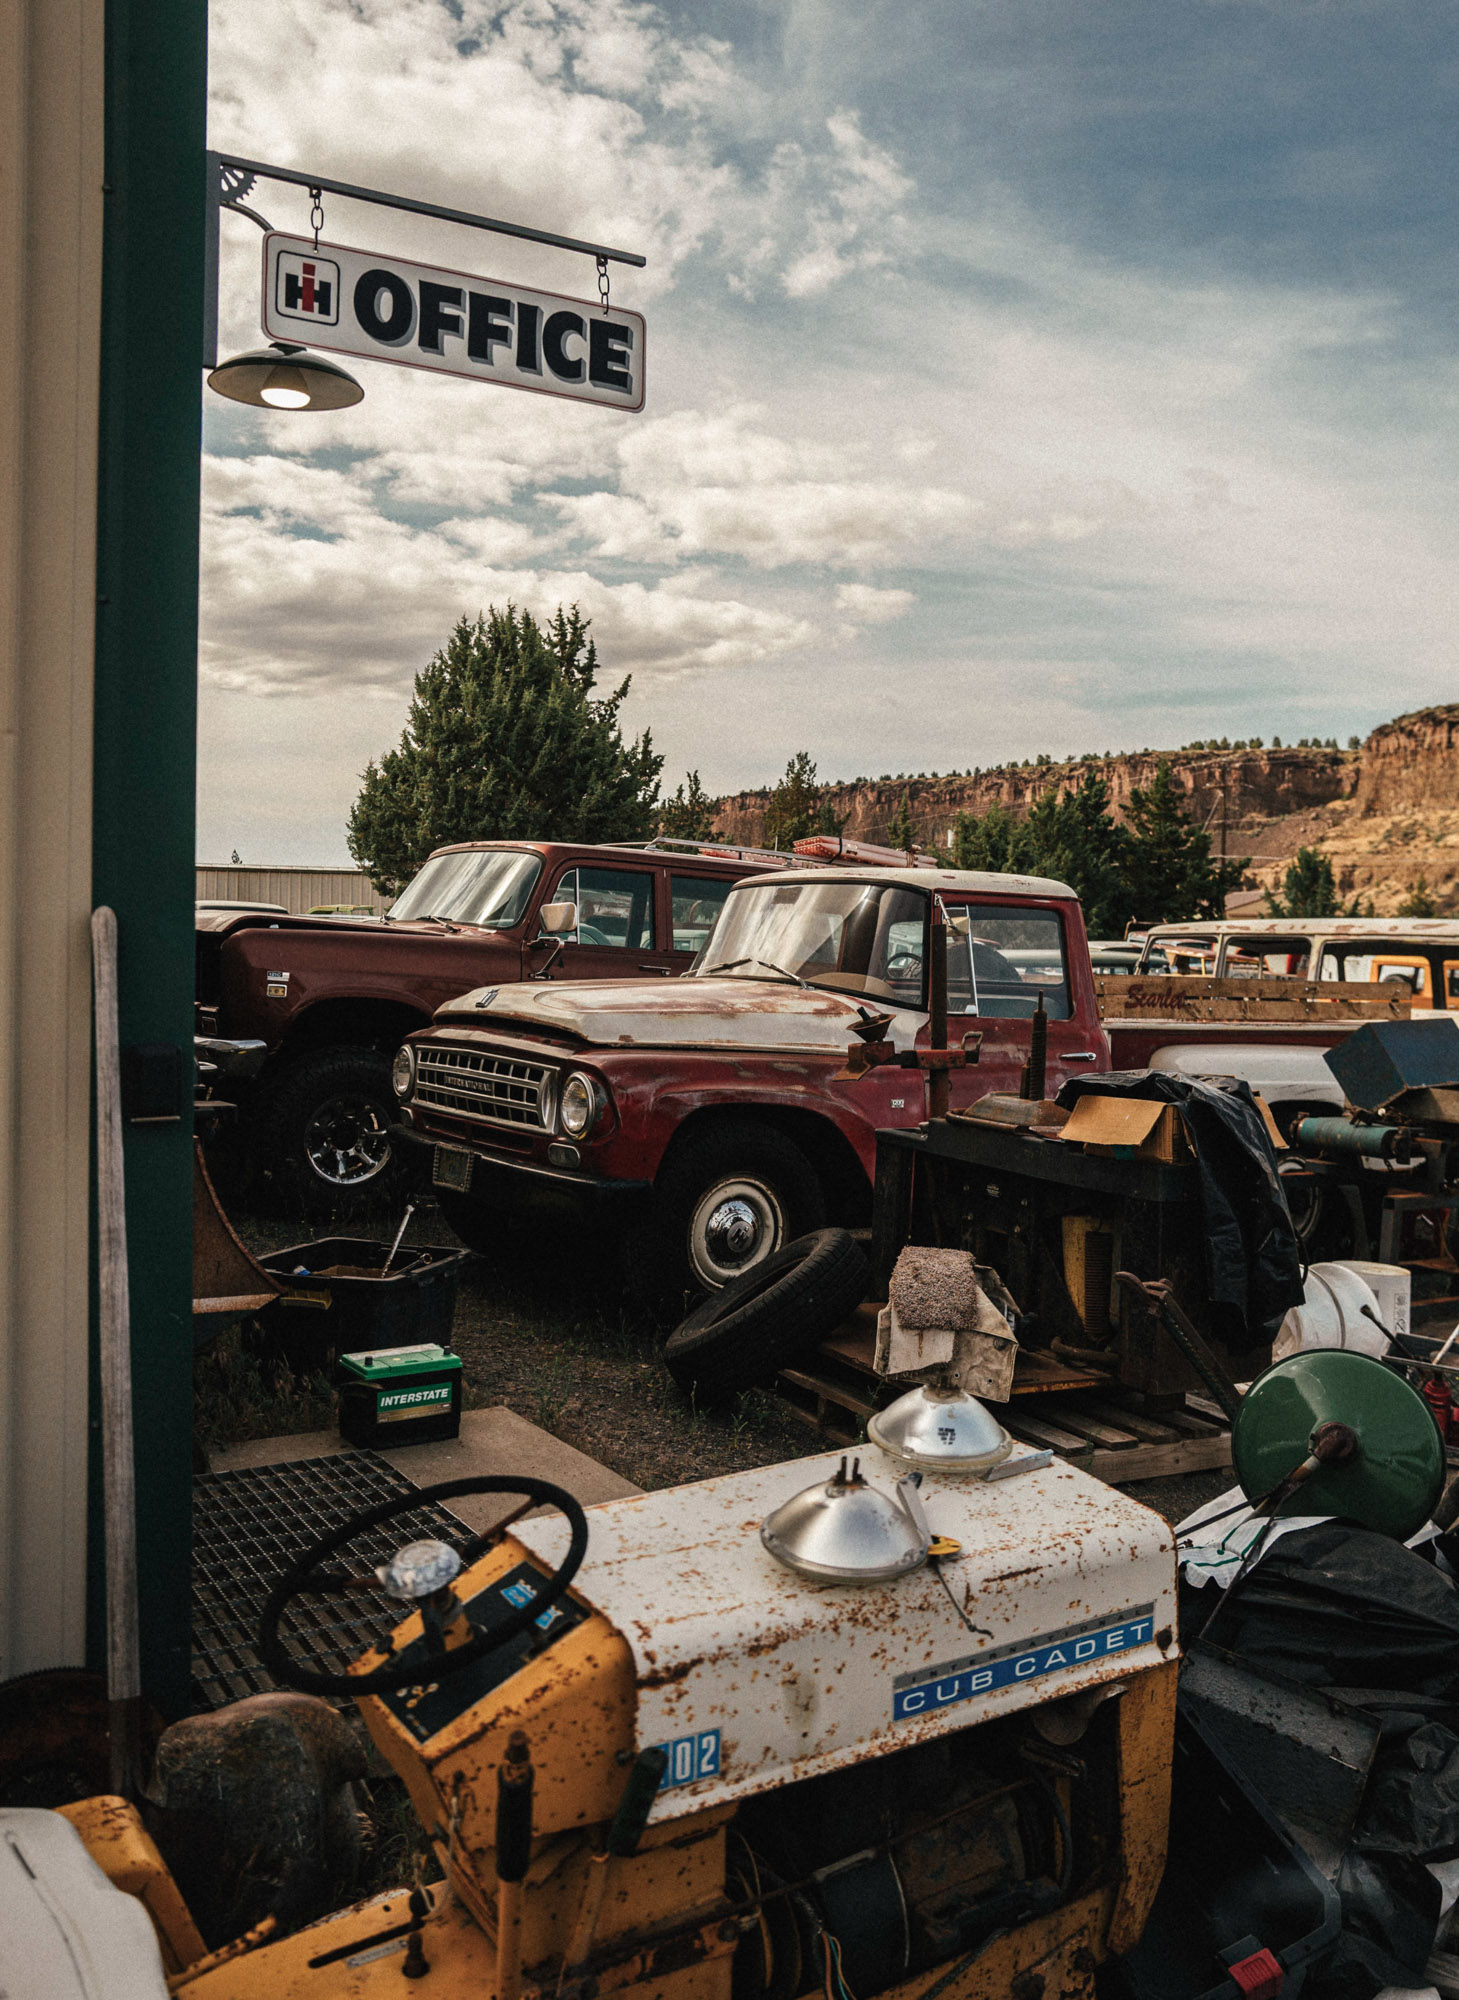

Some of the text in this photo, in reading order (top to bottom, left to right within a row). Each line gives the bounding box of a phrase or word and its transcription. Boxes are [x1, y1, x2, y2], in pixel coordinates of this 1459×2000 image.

[354, 269, 633, 396] OFFICE
[1125, 984, 1186, 1009] Scarlet
[380, 1388, 449, 1407] INTERSTATE
[902, 1622, 1150, 1712] CUB CADET
[912, 1609, 1142, 1683] INTERNATIONAL
[661, 1735, 717, 1784] 02
